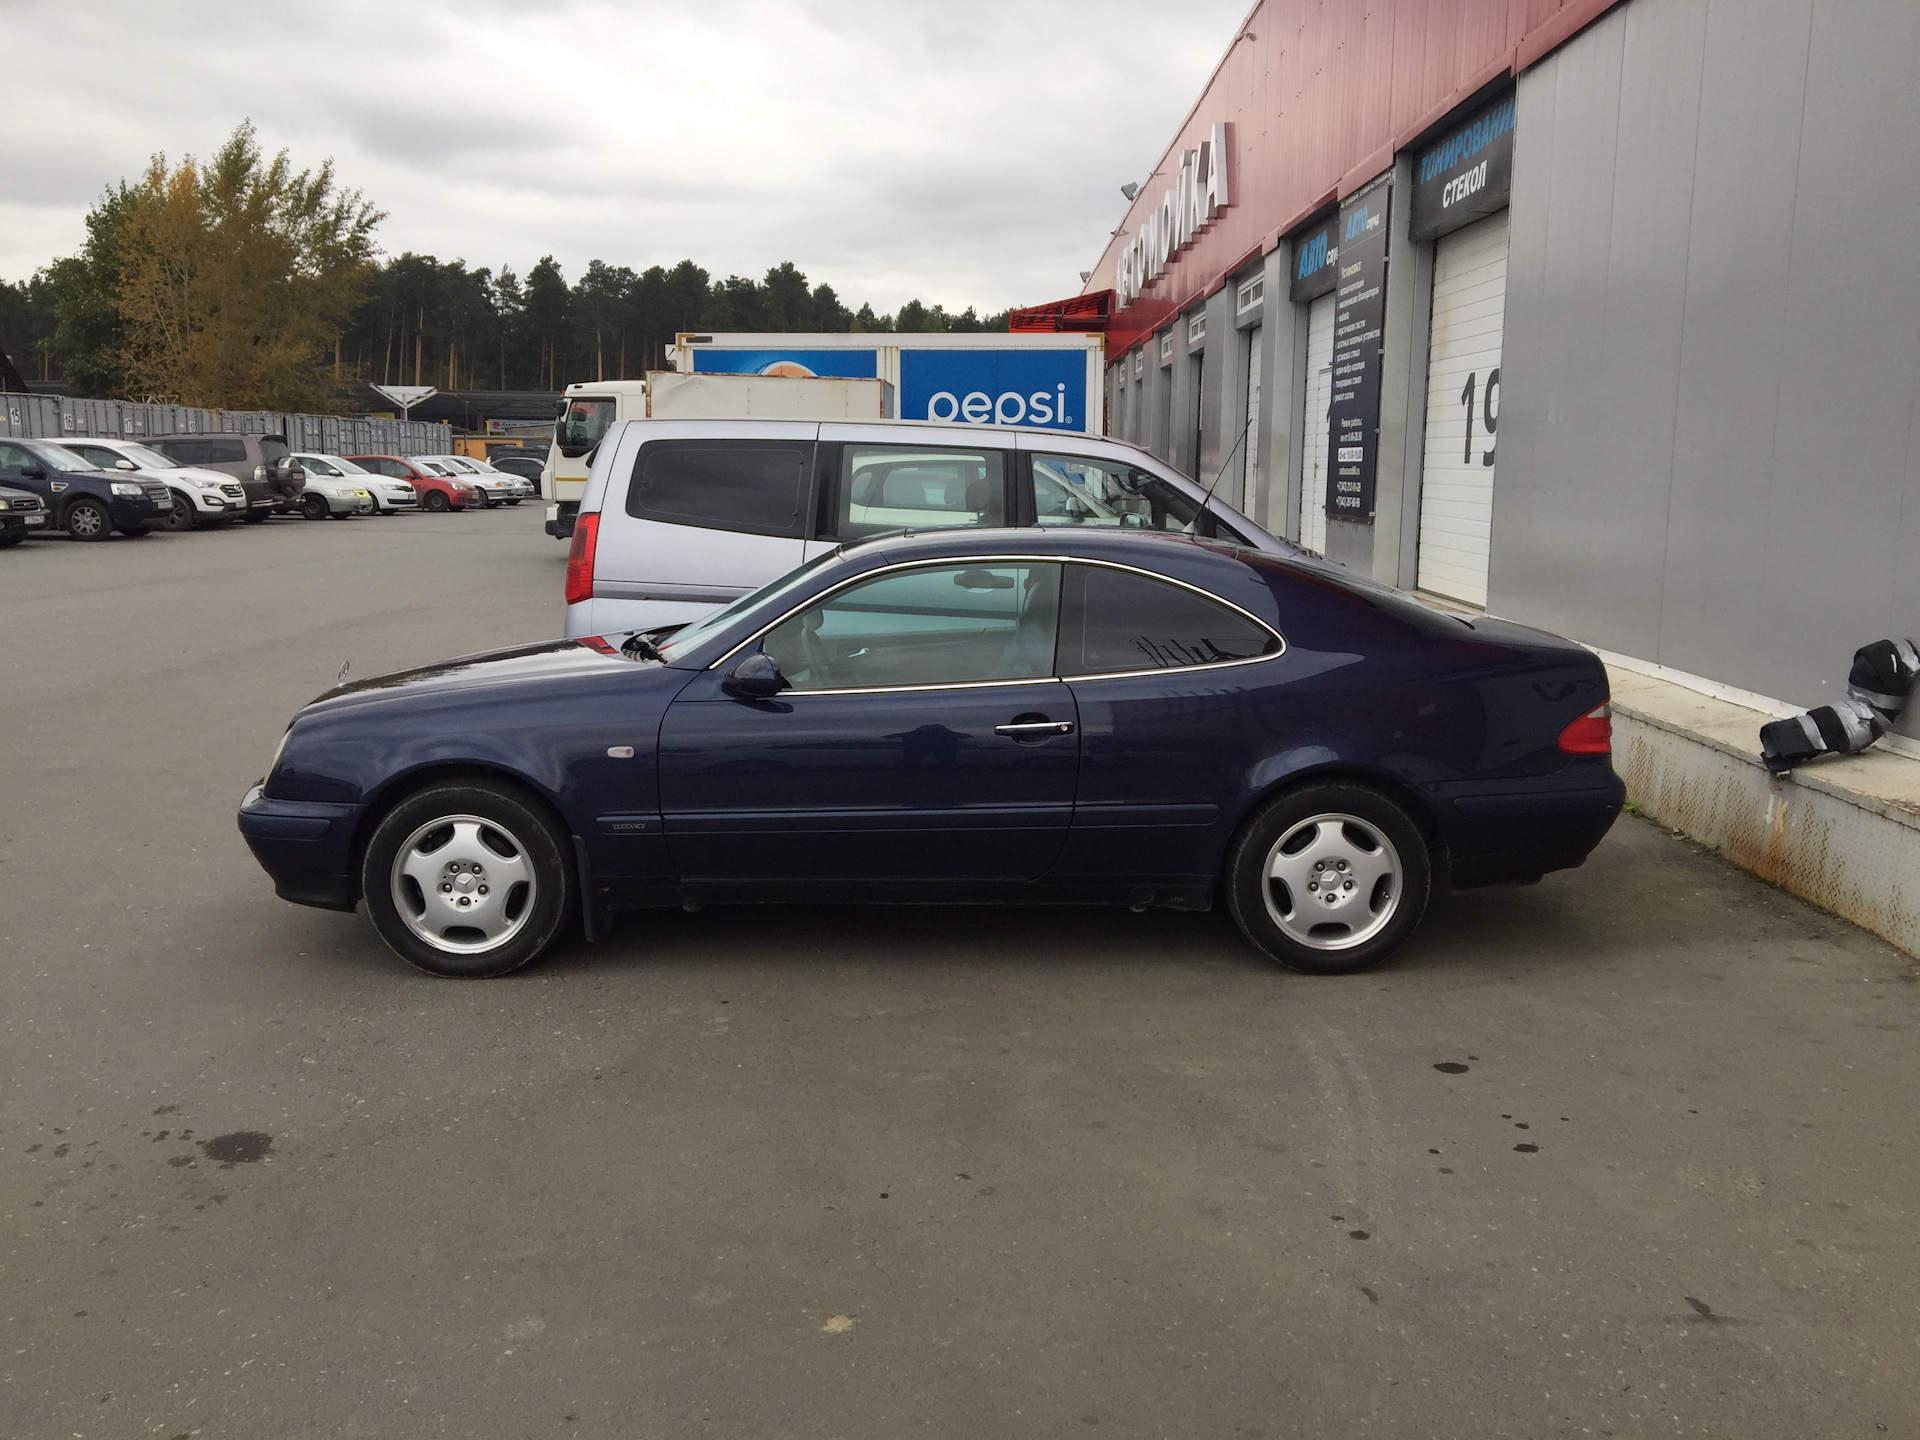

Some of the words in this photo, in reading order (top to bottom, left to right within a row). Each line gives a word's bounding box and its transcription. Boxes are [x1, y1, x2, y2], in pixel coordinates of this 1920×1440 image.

[1442, 160, 1487, 208] СТЕКОЛ
[11, 408, 20, 424] 15
[64, 414, 73, 429] 16
[928, 383, 1064, 424] pepsi
[1461, 368, 1499, 466] 19
